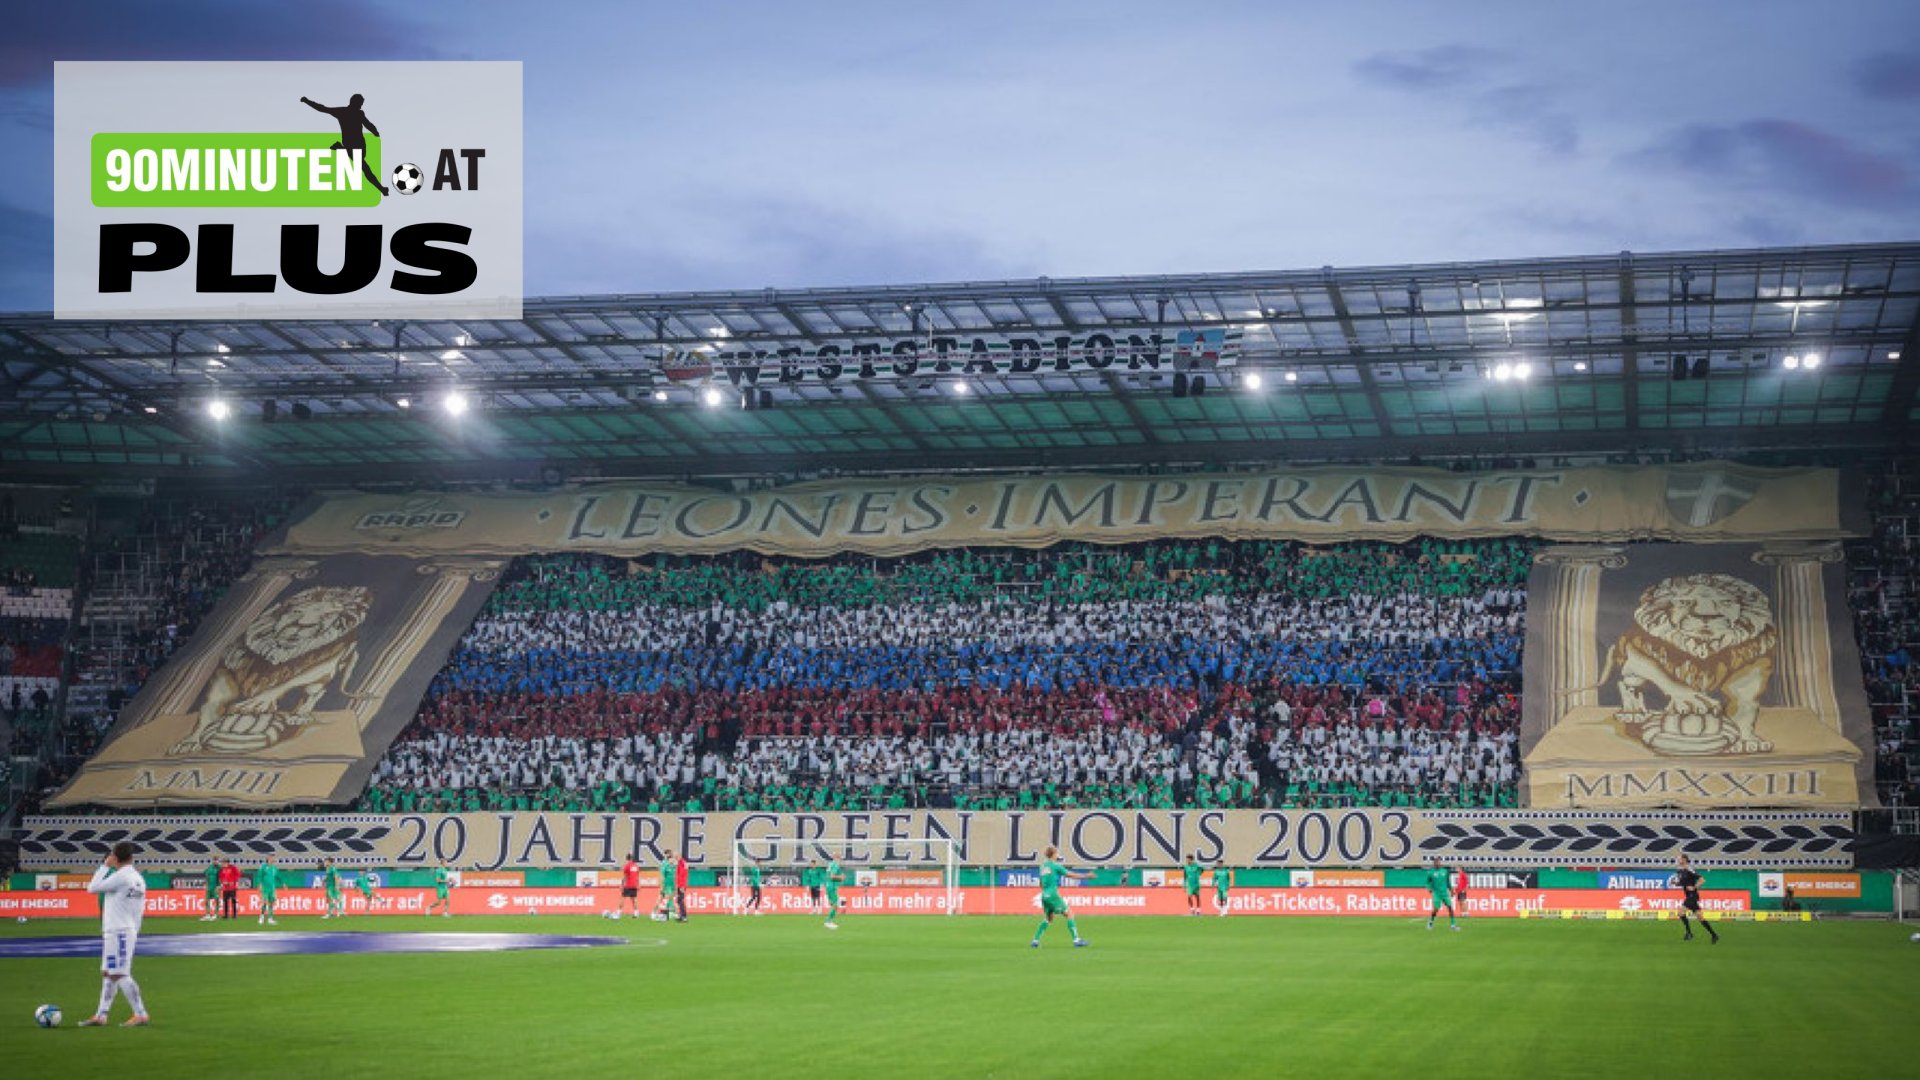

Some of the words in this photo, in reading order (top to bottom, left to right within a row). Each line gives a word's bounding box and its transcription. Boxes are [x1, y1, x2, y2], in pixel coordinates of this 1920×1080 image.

[718, 333, 1163, 386] WESTSTADION
[568, 486, 952, 541] LEONES
[990, 474, 1561, 530] IMPERANT
[1565, 769, 1821, 798] MMXXIII
[397, 814, 467, 863] 20
[475, 812, 706, 871] JAHRE
[735, 811, 972, 863] GREEN
[1007, 810, 1226, 863] LIONS
[1257, 811, 1412, 862] 2003
[1006, 873, 1040, 887] Allia
[1607, 875, 1663, 889] Allianz
[513, 895, 544, 906] WIEN
[546, 895, 595, 906] ENERGIE
[888, 892, 932, 909] mehr
[1093, 896, 1146, 907] ENERGIE
[1346, 892, 1417, 911] Rabatte
[1467, 893, 1511, 911] mehr
[1515, 893, 1546, 911] auf
[1697, 899, 1744, 910] NERGIE
